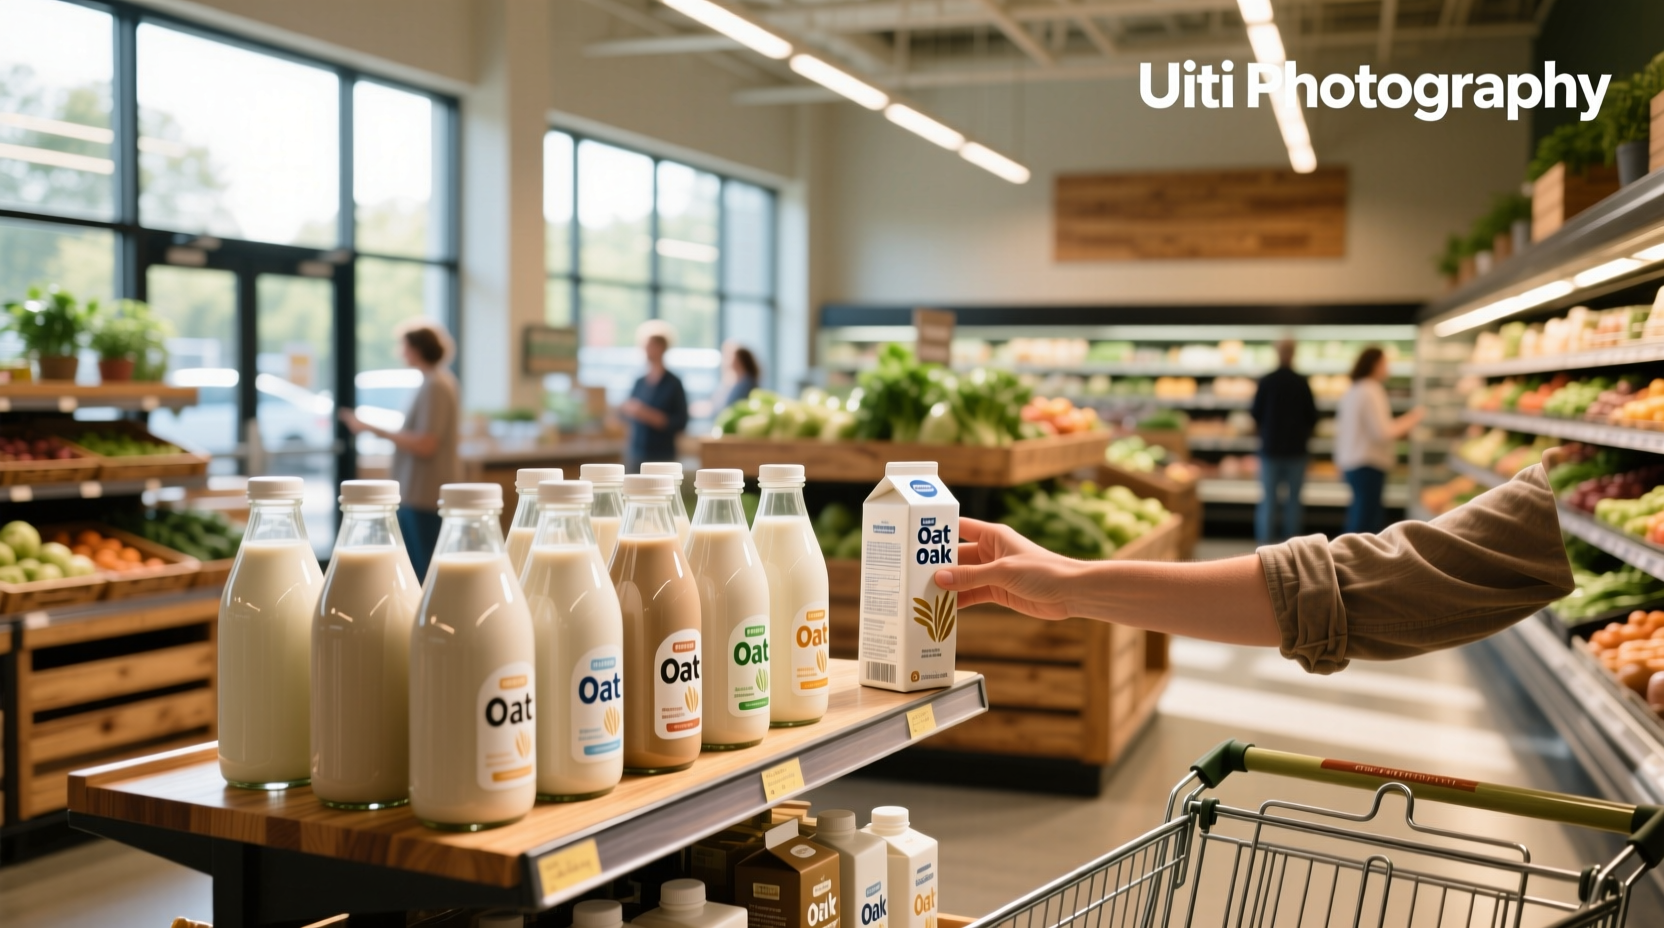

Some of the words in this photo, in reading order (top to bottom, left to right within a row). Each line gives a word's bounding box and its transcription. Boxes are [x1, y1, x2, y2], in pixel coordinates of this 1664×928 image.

[917, 525, 951, 545] Oat
[796, 622, 828, 648] Oat
[733, 638, 769, 666] Oat
[660, 654, 700, 684] Oat
[578, 672, 621, 705] Oat
[485, 693, 532, 727] Oat
[861, 894, 887, 926] Oak
[914, 886, 936, 916] Oat
